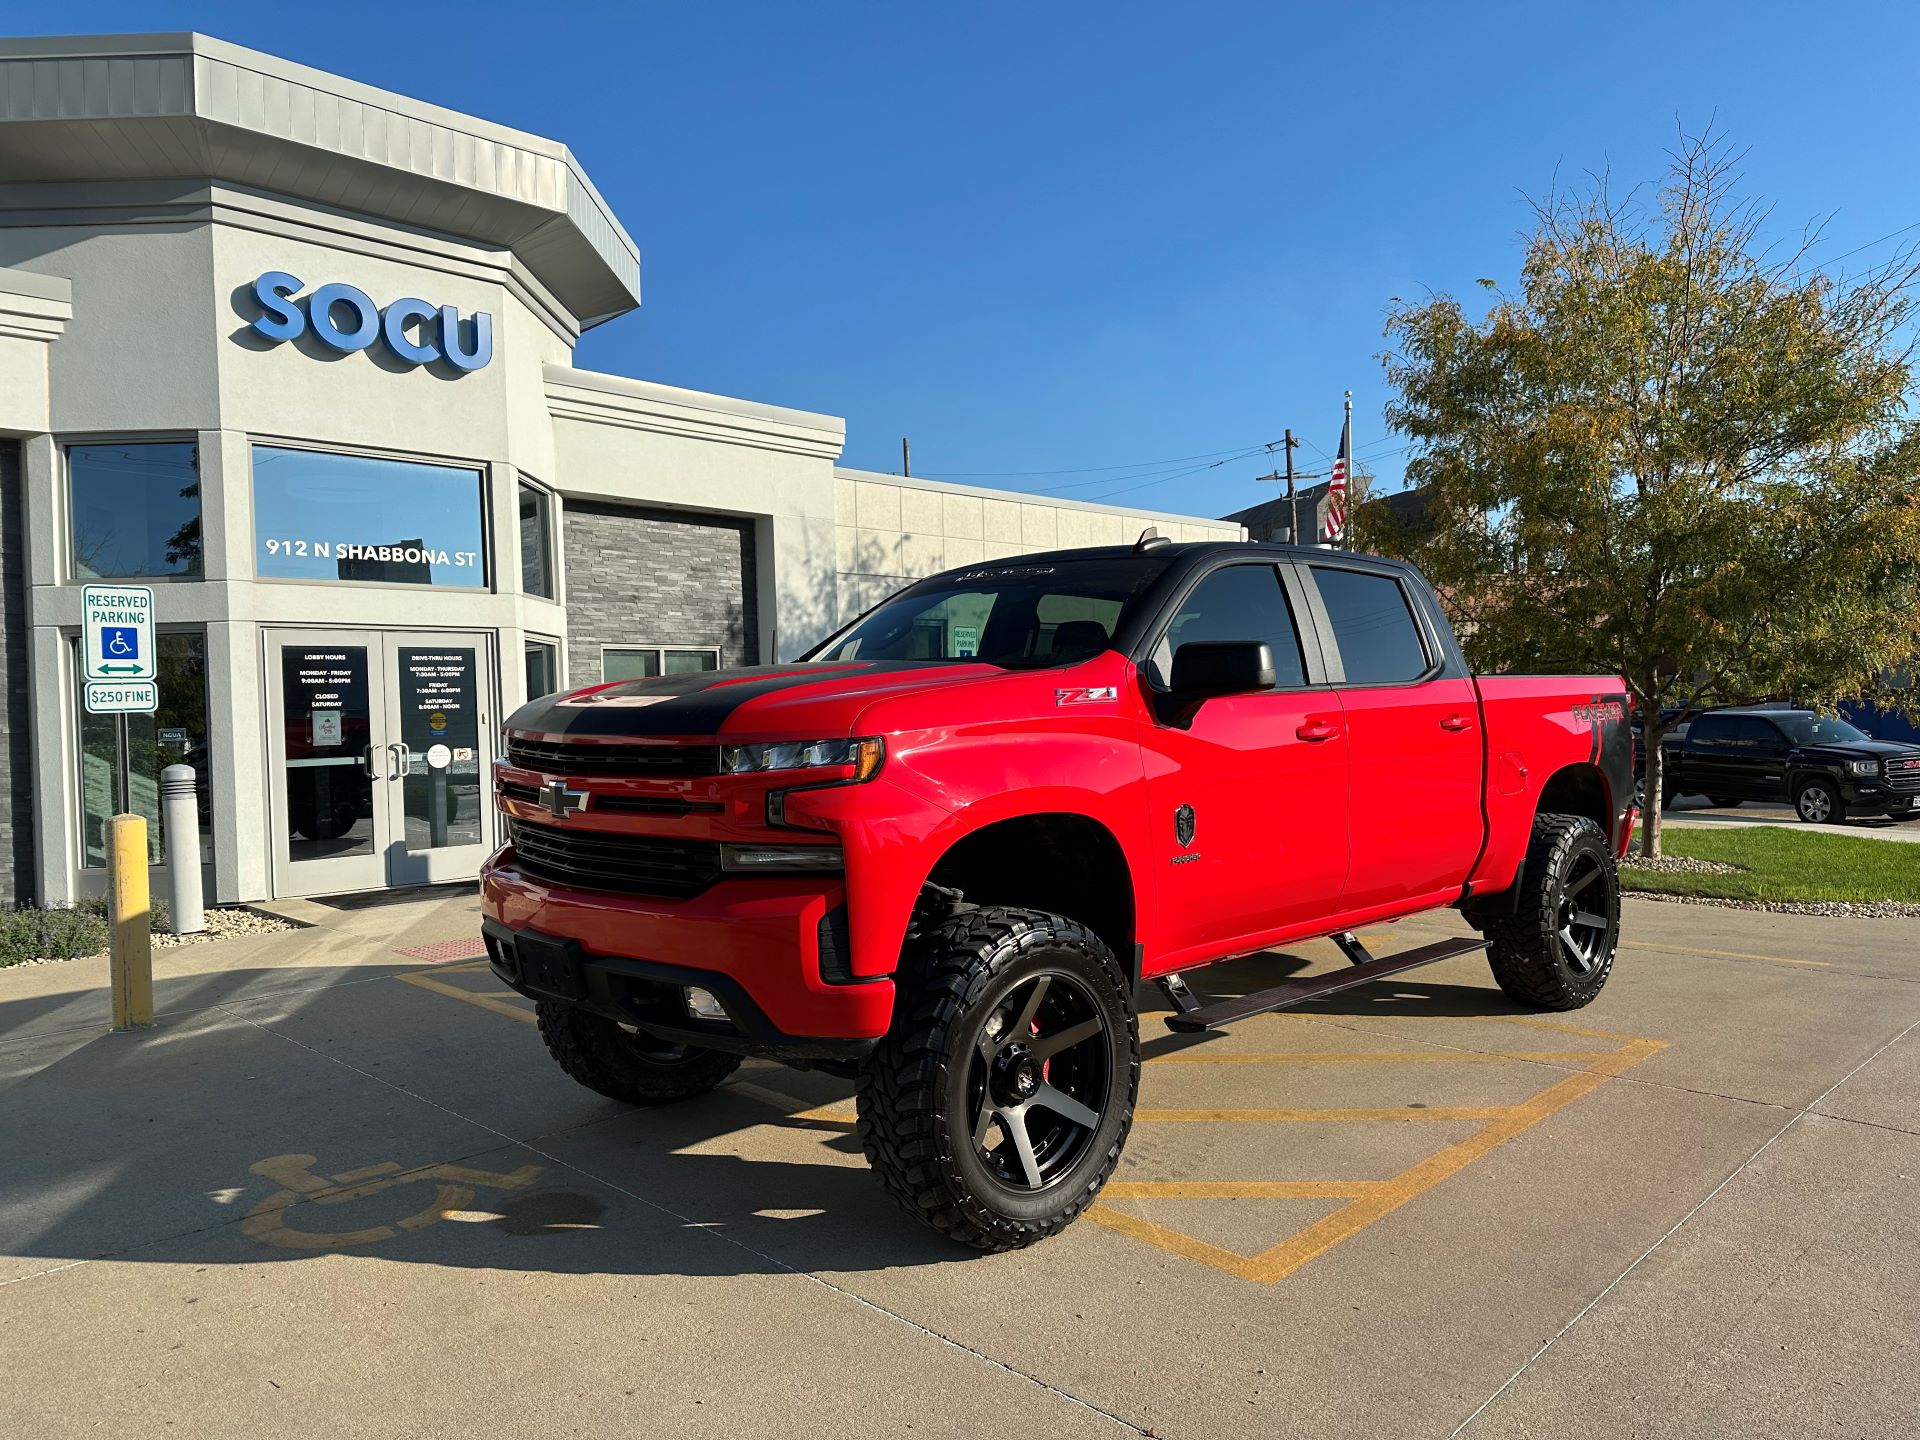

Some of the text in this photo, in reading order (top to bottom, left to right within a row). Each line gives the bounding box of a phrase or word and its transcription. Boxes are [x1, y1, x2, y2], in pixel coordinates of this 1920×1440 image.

[253, 271, 492, 371] SOCU
[265, 539, 476, 566] 912 N SHABBONA ST
[87, 594, 148, 608] RESERVED
[92, 611, 145, 624] PARKING
[91, 690, 152, 704] $250 FINE
